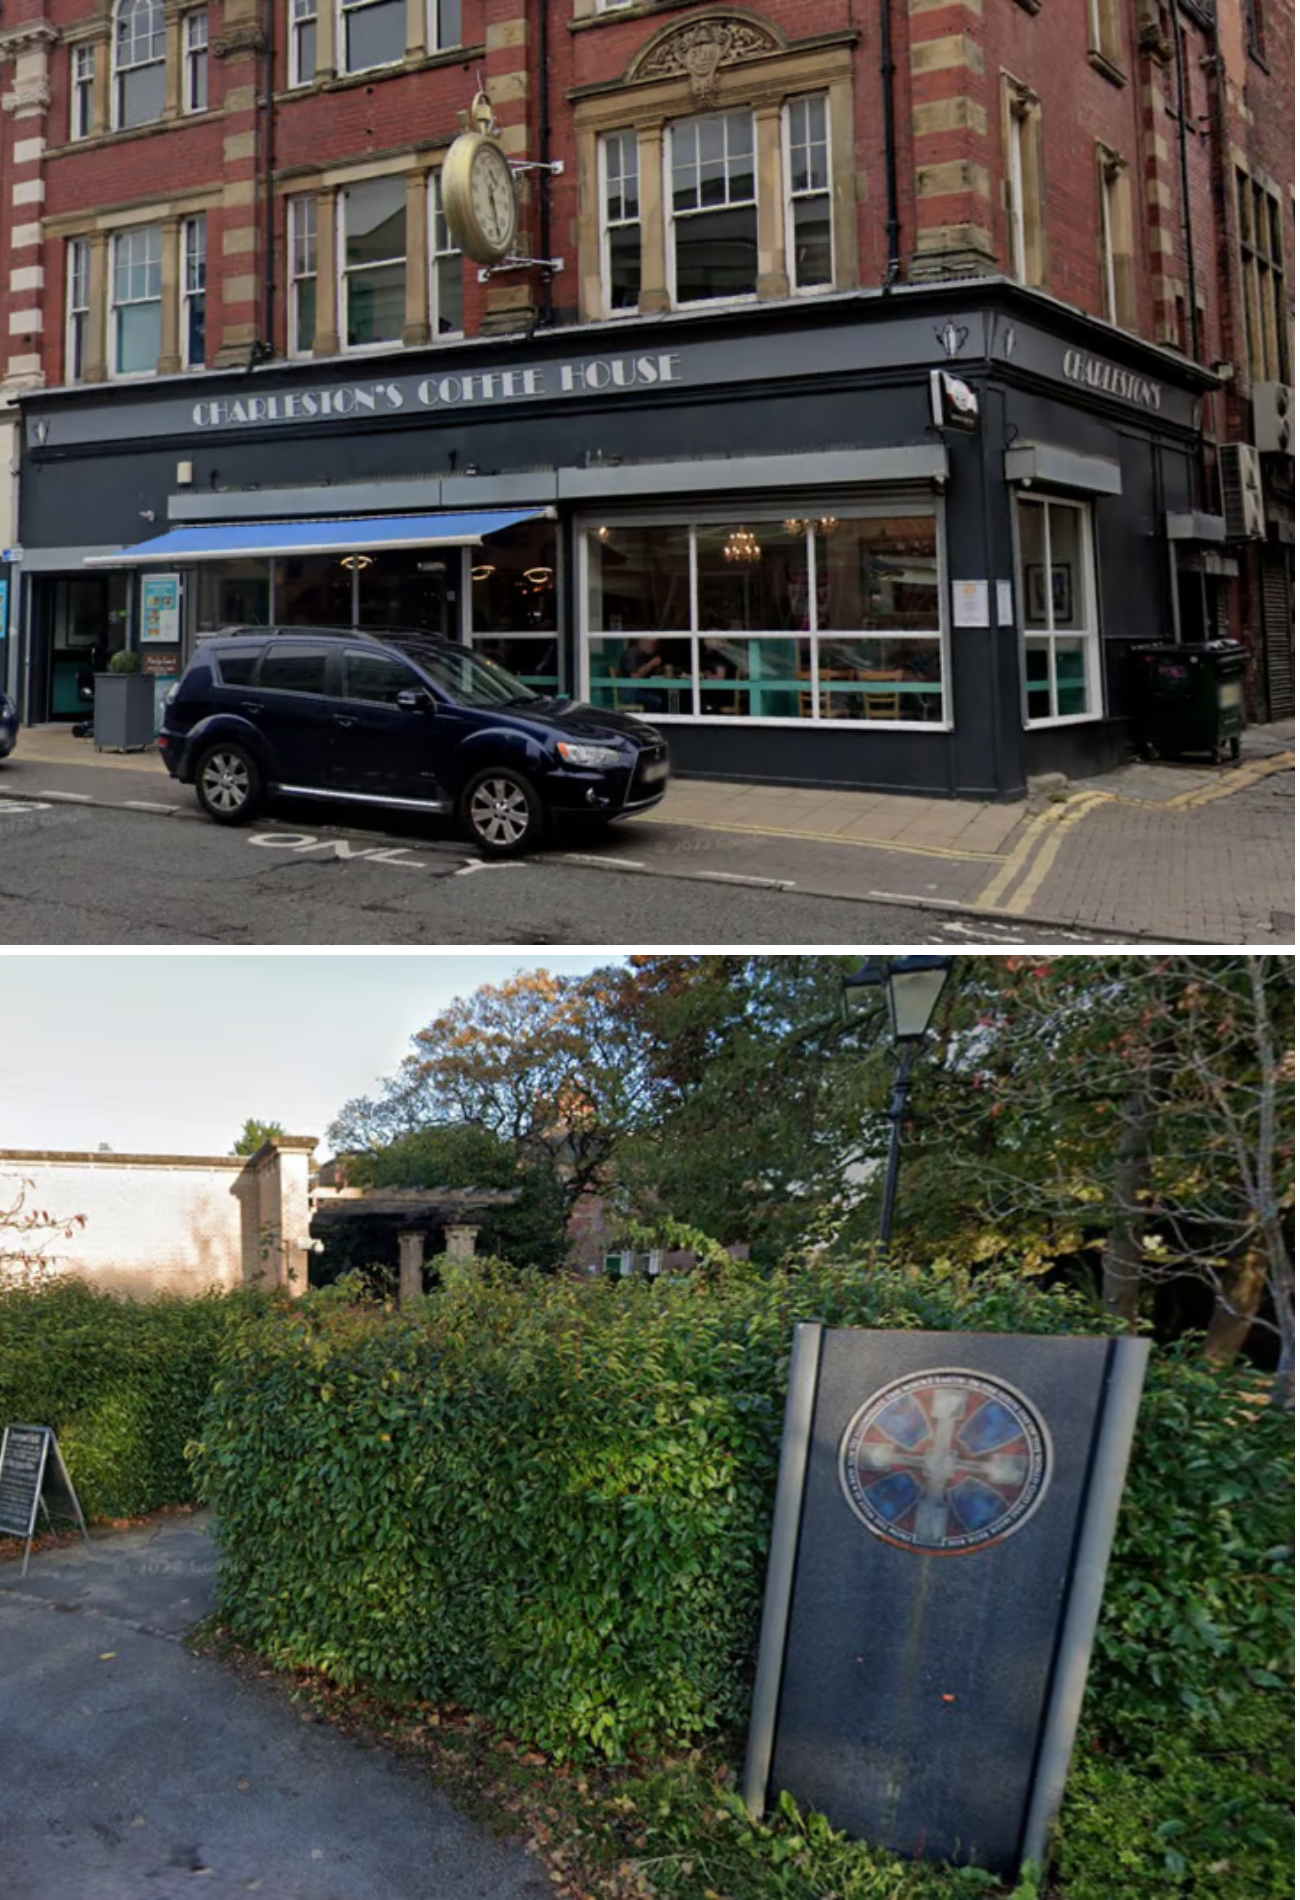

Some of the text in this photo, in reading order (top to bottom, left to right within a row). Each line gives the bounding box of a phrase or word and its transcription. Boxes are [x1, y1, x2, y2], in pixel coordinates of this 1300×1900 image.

[193, 353, 683, 426] CHARLESTON'S COFFEE HOUSE
[1063, 349, 1161, 411] CHARLESTON'S
[247, 832, 528, 875] ONLY
